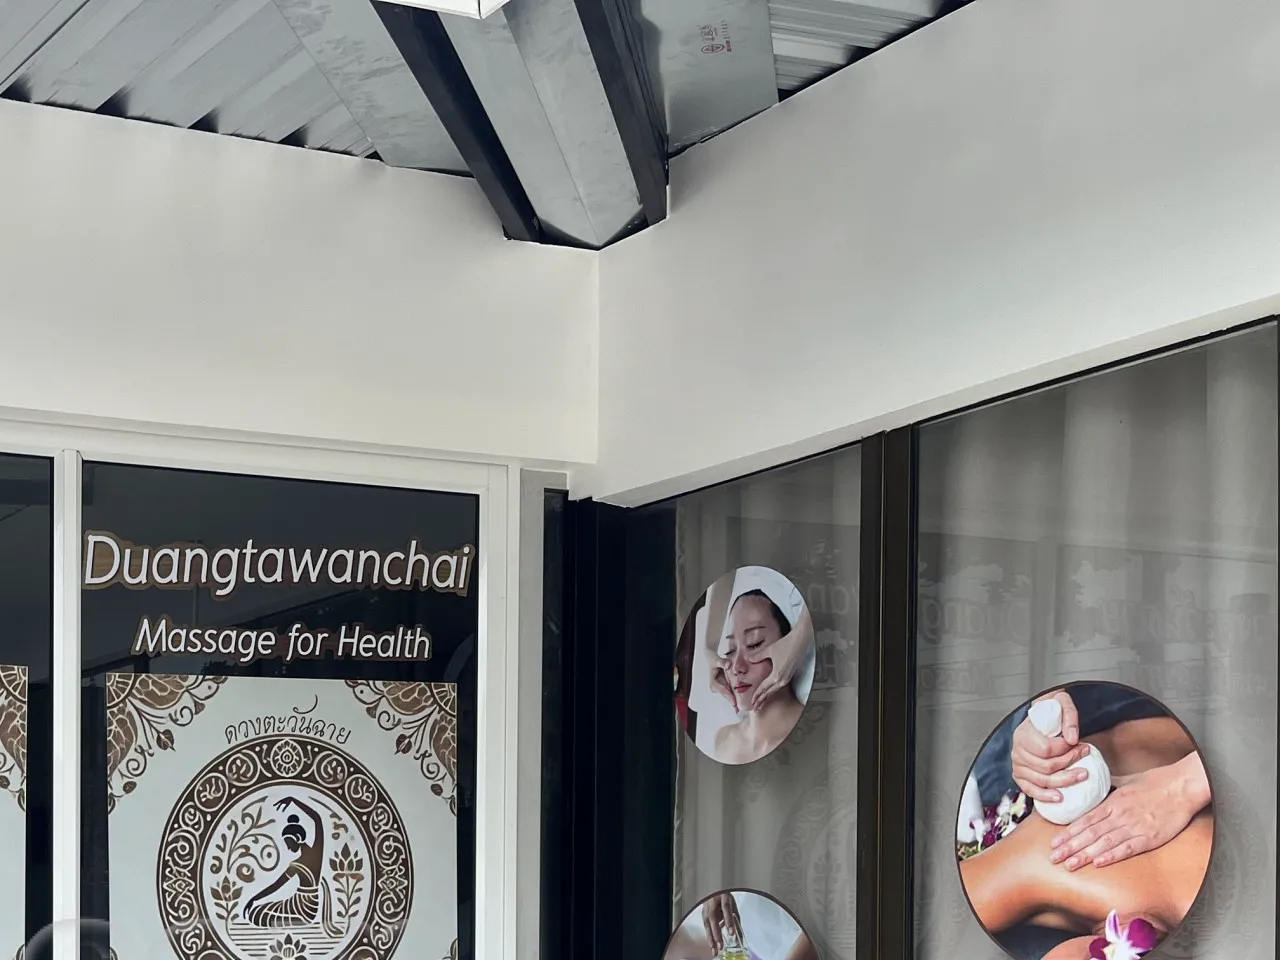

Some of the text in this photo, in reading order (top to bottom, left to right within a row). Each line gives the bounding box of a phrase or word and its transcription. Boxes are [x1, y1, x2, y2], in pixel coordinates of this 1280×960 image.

[85, 534, 471, 596] Duangtawanchai
[135, 618, 431, 662] Massage for Health
[225, 694, 351, 744] ดวงตะวันฉาย
